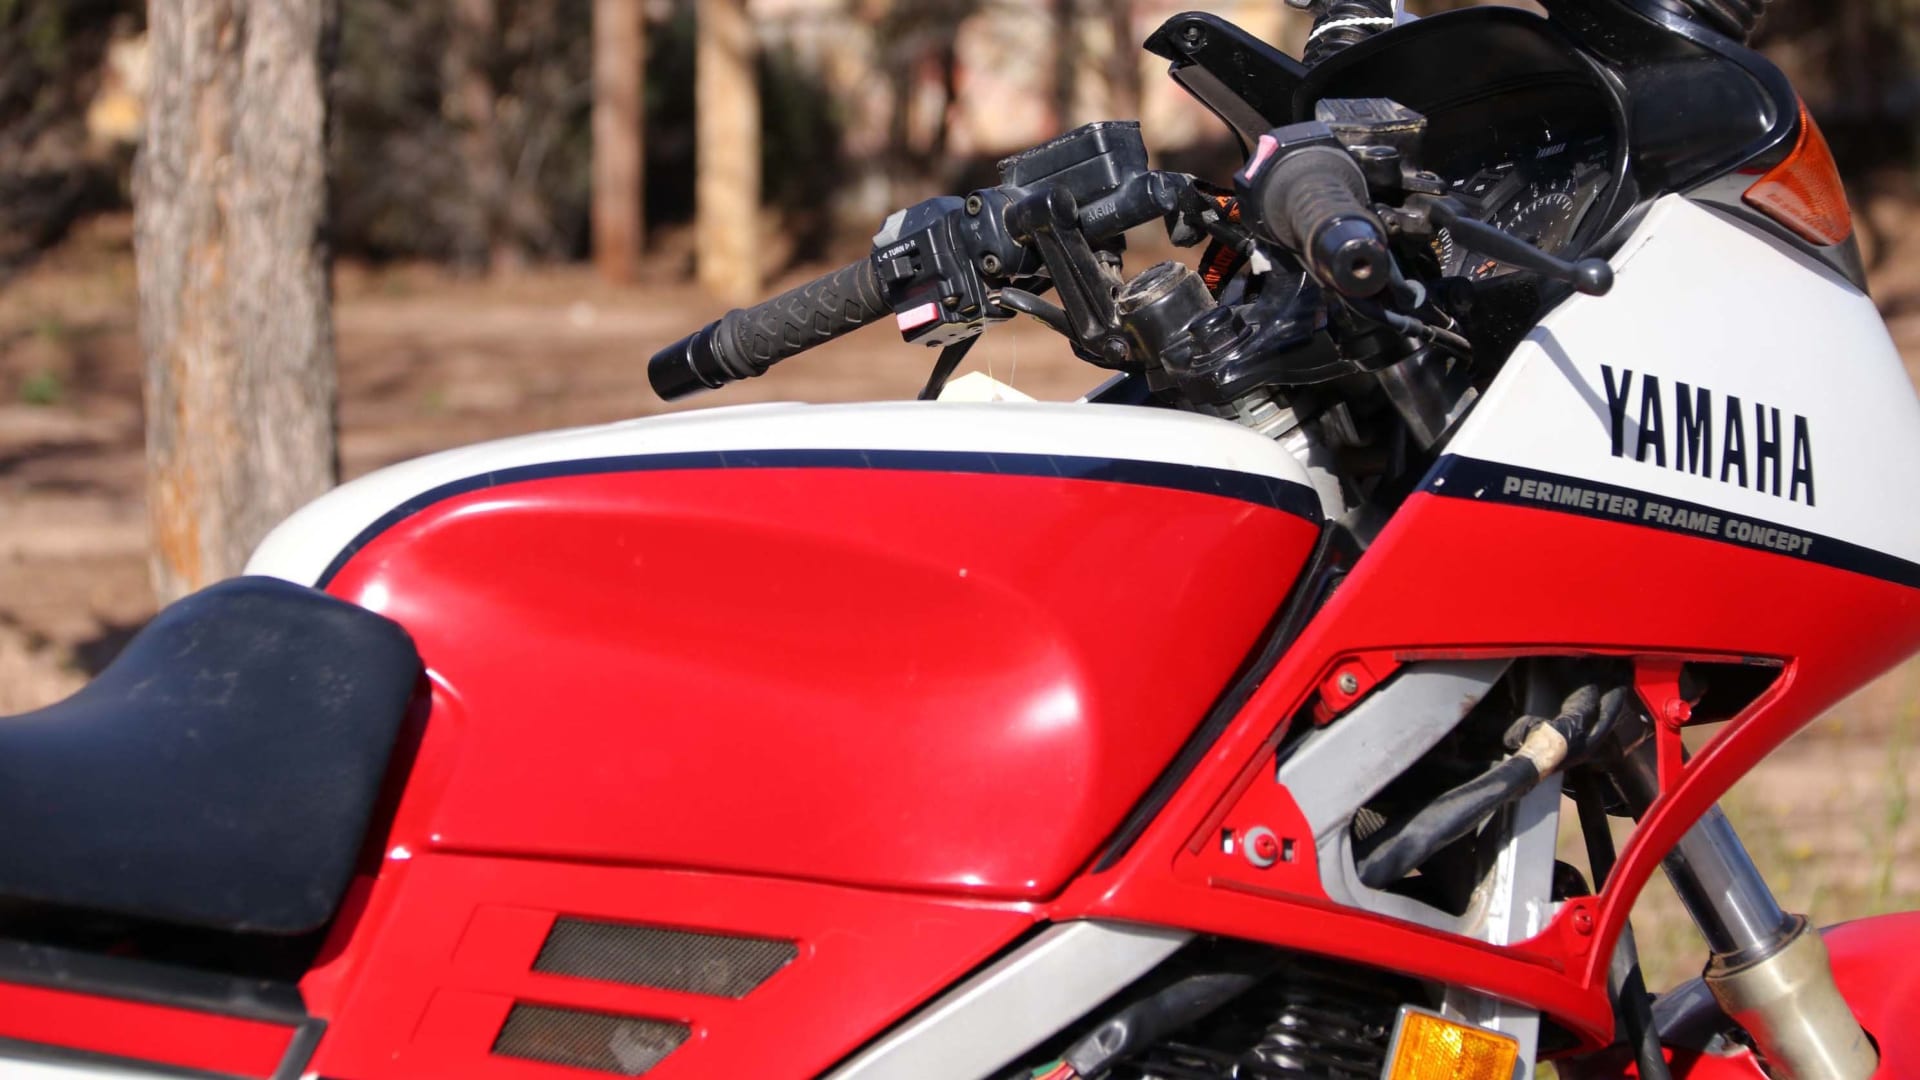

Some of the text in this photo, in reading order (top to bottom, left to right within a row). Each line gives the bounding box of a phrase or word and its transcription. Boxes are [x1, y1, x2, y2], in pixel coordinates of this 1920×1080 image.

[1601, 364, 1815, 507] YAMAHA
[1503, 475, 1813, 556] PERIMETER FRAME CONCEPT
